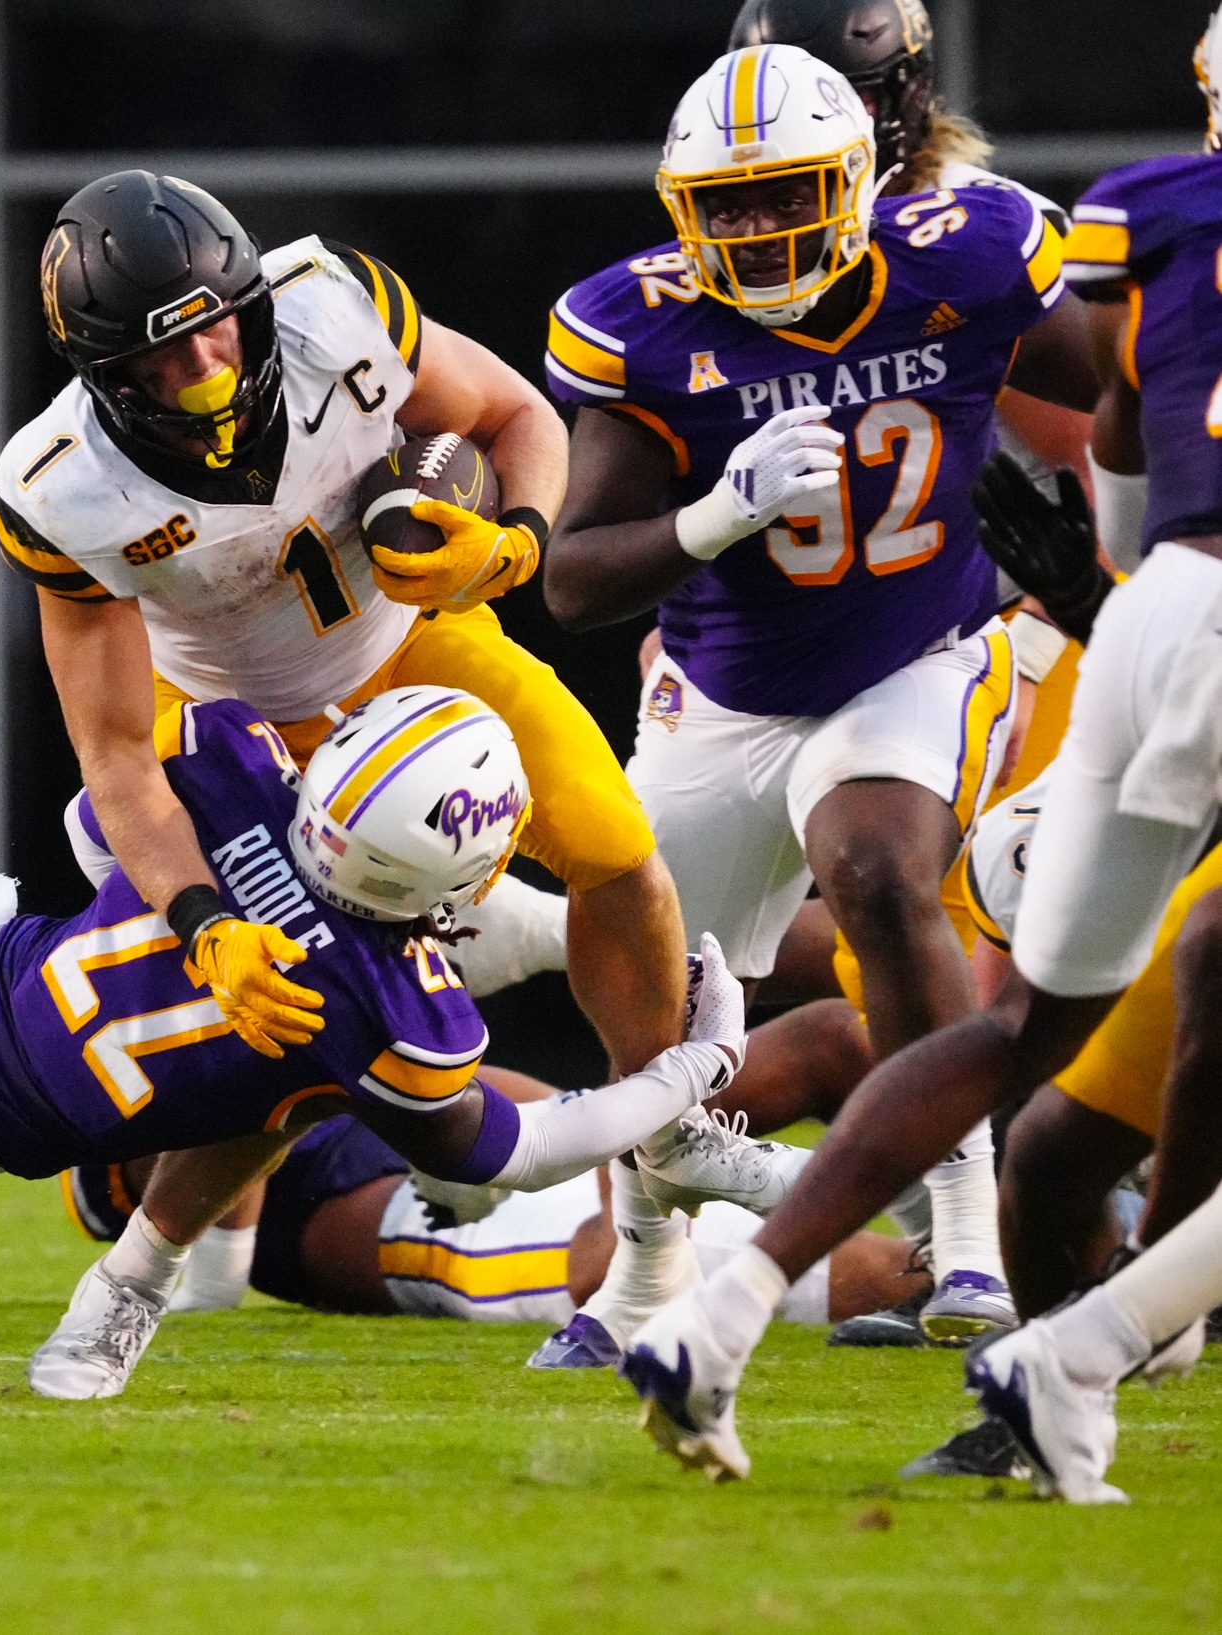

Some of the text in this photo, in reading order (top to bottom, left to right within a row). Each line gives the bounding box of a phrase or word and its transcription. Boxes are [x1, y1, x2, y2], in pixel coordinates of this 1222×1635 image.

[895, 188, 969, 249] 92
[628, 251, 702, 309] 92
[342, 357, 388, 417] C
[735, 342, 948, 420] PIRATES
[17, 433, 81, 492] 1
[121, 513, 198, 567] SBC
[276, 515, 361, 638] 1
